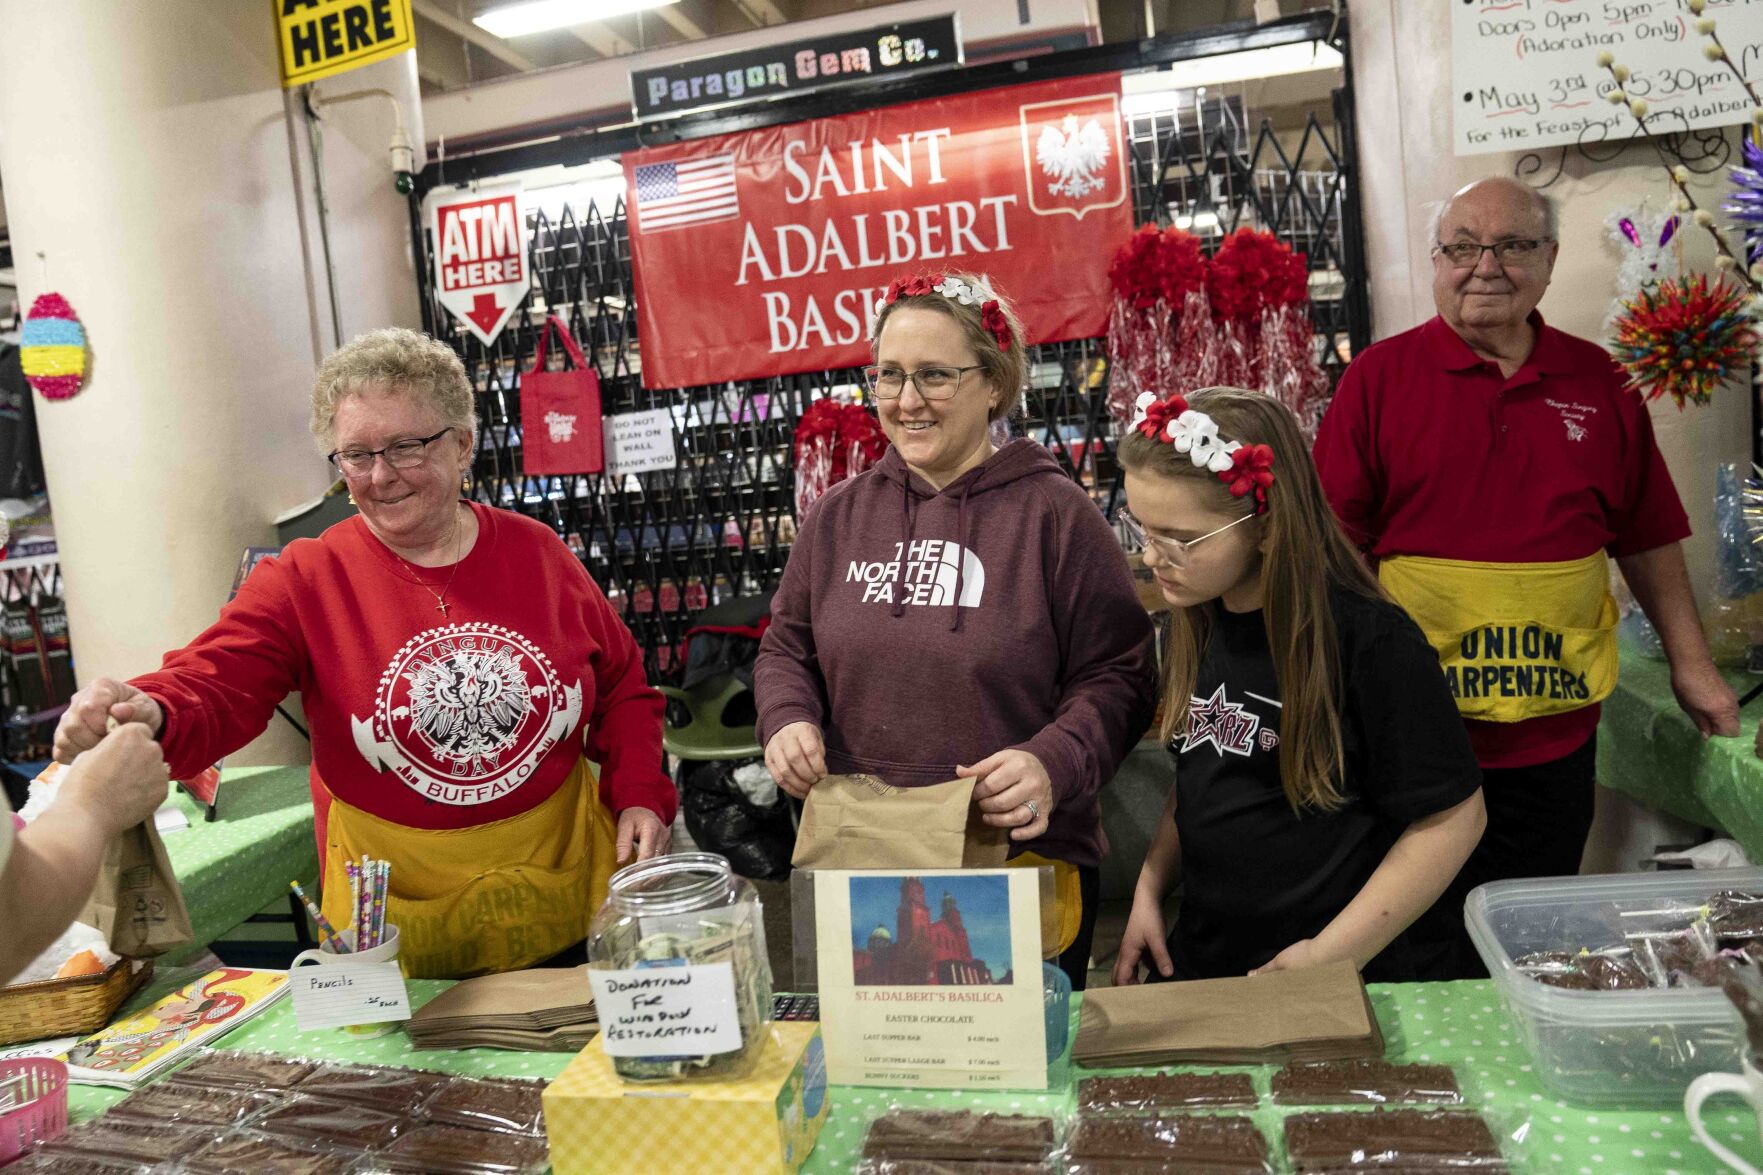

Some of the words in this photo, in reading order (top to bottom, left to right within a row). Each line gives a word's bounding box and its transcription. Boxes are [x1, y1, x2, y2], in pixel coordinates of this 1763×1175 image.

[290, 0, 396, 68] HERE
[1478, 20, 1536, 37] Doors
[1545, 10, 1590, 31] Open
[647, 61, 788, 106] Paragon
[794, 47, 872, 79] Gem
[878, 34, 939, 67] Co.
[1479, 85, 1540, 115] May
[1547, 74, 1588, 103] 3rd
[1501, 126, 1529, 139] the
[1536, 117, 1590, 135] Feast
[783, 127, 952, 205] SAINT
[442, 201, 519, 265] ATM
[734, 194, 1018, 286] ADALBERT
[444, 257, 520, 289] HERE
[761, 284, 891, 353] BASI
[613, 432, 642, 441] LEAN
[645, 429, 661, 438] ON
[614, 420, 631, 429] DO
[633, 417, 655, 426] NOT
[623, 442, 653, 451] WALL
[609, 459, 646, 469] THANK
[650, 455, 674, 464] YOU
[894, 539, 944, 562] THE
[845, 560, 939, 583] NORTH
[1461, 625, 1563, 661] UNION
[408, 636, 516, 676] DYNGUS
[1444, 664, 1591, 700] ARPENTERS
[450, 754, 502, 777] DAY
[426, 763, 531, 802] BUFFALO
[605, 971, 692, 994] DONATION
[631, 993, 664, 1010] FOR
[855, 991, 870, 1001] ST.
[873, 991, 945, 1002] ADALBERT'S
[948, 992, 1004, 1003] BASILICA
[885, 1014, 919, 1023] EASTER
[920, 1015, 975, 1024] CHOCOLATE
[607, 1024, 718, 1041] RESTORATION
